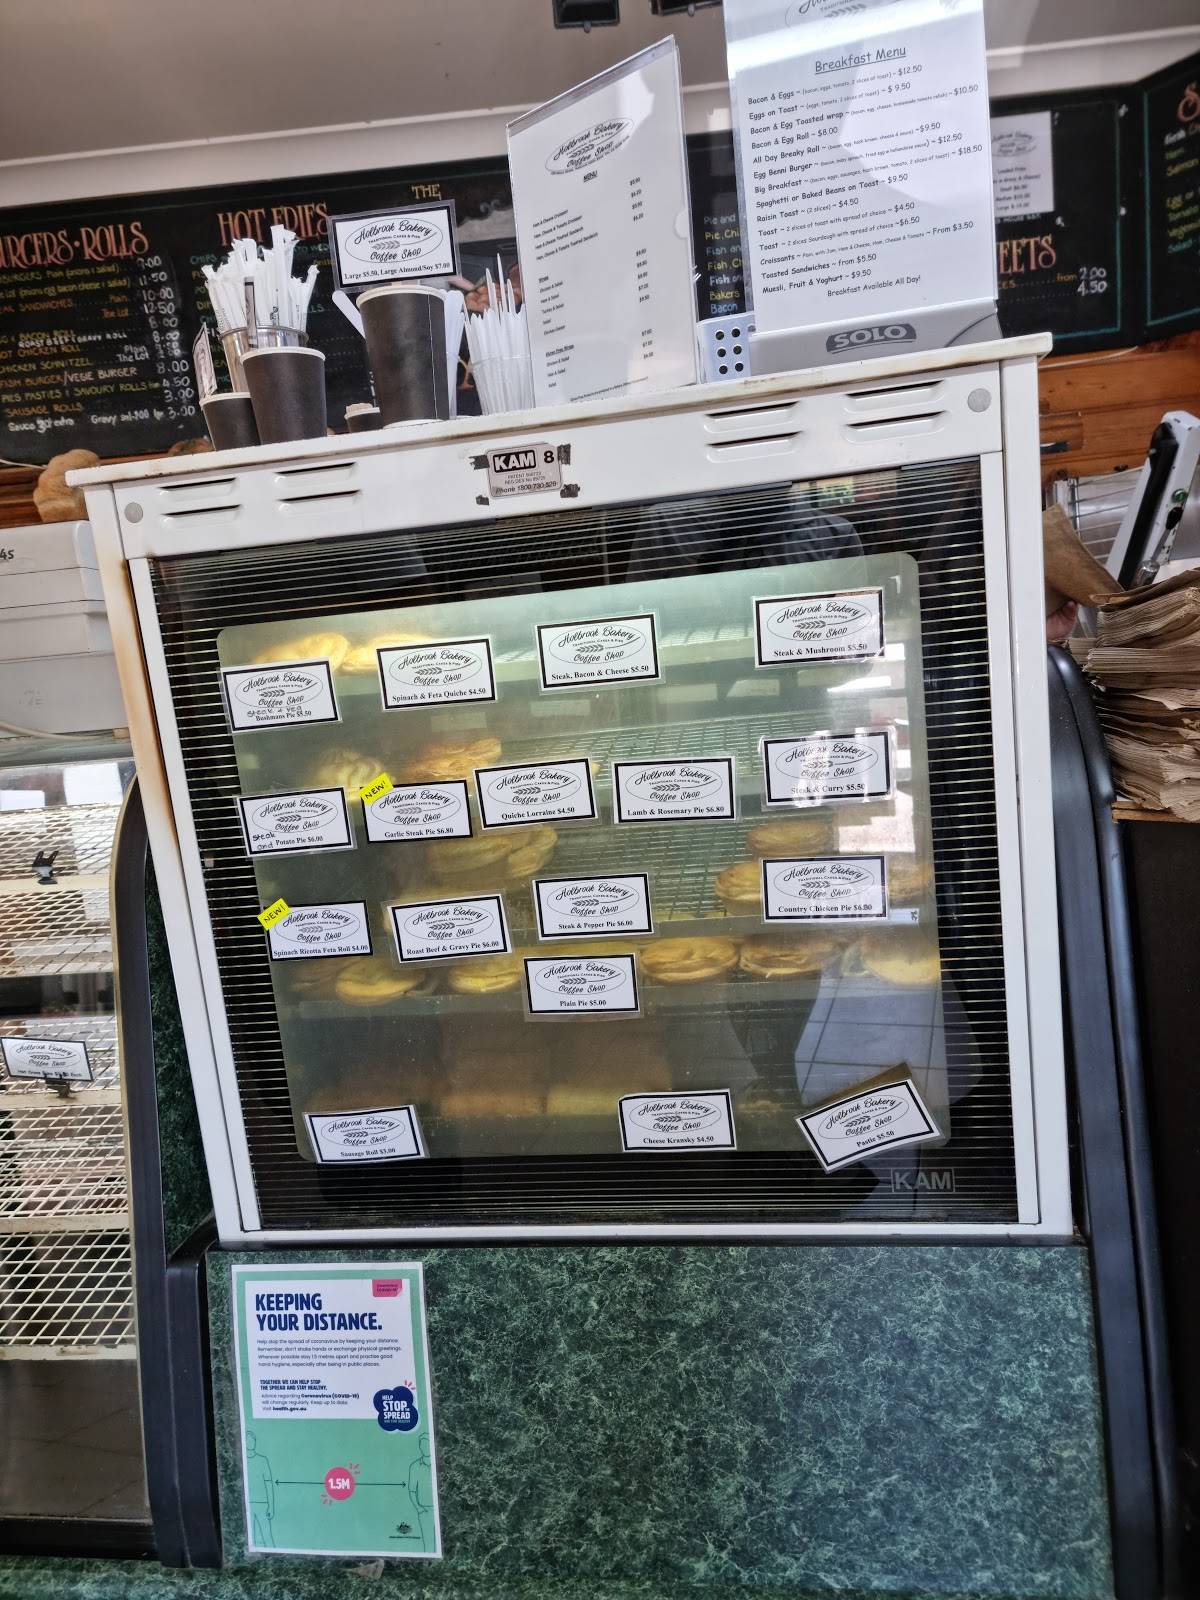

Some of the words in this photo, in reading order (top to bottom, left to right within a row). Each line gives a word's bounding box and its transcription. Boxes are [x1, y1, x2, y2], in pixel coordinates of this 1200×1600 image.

[814, 48, 872, 73] Breakfast
[875, 45, 907, 64] Menu
[748, 96, 768, 105] Bacon
[770, 93, 776, 101] &
[778, 90, 795, 100] Eggs
[898, 64, 922, 76] $12.50
[752, 141, 771, 150] Bacon
[781, 136, 794, 144] Egg
[796, 131, 810, 140] Roll
[817, 126, 838, 137] $8.00
[583, 170, 598, 183] MENU
[411, 184, 441, 200] THE
[756, 214, 777, 222] Raisin
[779, 209, 799, 218] Toast
[838, 197, 859, 208] $4.50
[217, 208, 266, 247] HOT
[354, 222, 395, 245] Holbrook
[398, 220, 432, 237] Bakery
[80, 221, 149, 262] ROLLS
[370, 251, 398, 262] Coffee
[401, 248, 422, 259] Shop
[760, 254, 795, 265] Croissants
[344, 272, 362, 280] Large
[380, 268, 397, 276] Large
[399, 265, 433, 274] Almond/Soy
[761, 268, 789, 279] Toasted
[792, 263, 830, 275] Sandwiches
[838, 259, 855, 267] from
[856, 253, 877, 264] $5.50
[762, 285, 786, 294] Muesli,
[789, 281, 806, 289] Fruit
[816, 274, 843, 286] Yoghurt
[851, 268, 872, 279] $9.50
[827, 286, 861, 297] Breakfast
[863, 280, 893, 291] Available
[895, 277, 905, 285] All
[906, 274, 921, 284] Day!
[711, 303, 738, 314] Bacon
[831, 324, 908, 349] SOLO
[494, 452, 536, 472] KAM
[543, 450, 555, 463] 8
[777, 604, 822, 624] Holbrook
[825, 602, 860, 617] Bakery
[558, 628, 599, 647] Holbrook
[602, 626, 636, 640] Bakery
[792, 630, 822, 641] Coffee
[826, 627, 848, 638] Shop
[573, 654, 600, 664] Coffee
[604, 651, 624, 661] Shop
[774, 649, 794, 657] Steak
[796, 648, 803, 656] &
[805, 646, 846, 655] Mushroom
[574, 671, 595, 679] Bacon
[605, 668, 629, 676] Cheese
[630, 665, 649, 673] $5.50
[392, 694, 418, 703] Spinach
[444, 690, 467, 698] Quiche
[297, 710, 312, 718] $5.50
[634, 768, 676, 785] Holbrook
[679, 766, 712, 782] Bakery
[365, 780, 386, 800] NEW!
[649, 792, 677, 802] Coffee
[680, 791, 700, 801] Shop
[501, 812, 525, 820] Quiche
[526, 810, 556, 818] Lorraine
[557, 807, 575, 815] $4.50
[657, 807, 692, 816] Rosemary
[307, 835, 324, 843] $6.00
[384, 830, 405, 838] Garlic
[405, 829, 424, 837] Steak
[436, 827, 454, 835] $6.80
[778, 906, 807, 914] Country
[273, 949, 299, 957] Spinach
[449, 944, 469, 952] Gravy
[589, 999, 607, 1007] $5.00
[638, 1101, 677, 1116] Holbrook
[680, 1101, 711, 1114] Bakery
[652, 1122, 679, 1133] Coffee
[682, 1122, 701, 1131] Shop
[696, 1135, 714, 1143] $4.50
[856, 1137, 876, 1148] Pastie
[877, 1130, 895, 1141] $5.50
[893, 1171, 952, 1191] KAM
[255, 1293, 323, 1312] KEEPING
[256, 1313, 299, 1331] YOUR
[303, 1312, 383, 1331] DISTANCE.
[382, 1401, 407, 1411] STOP
[384, 1412, 411, 1420] SPREAD
[328, 1478, 350, 1490] 1.5M
